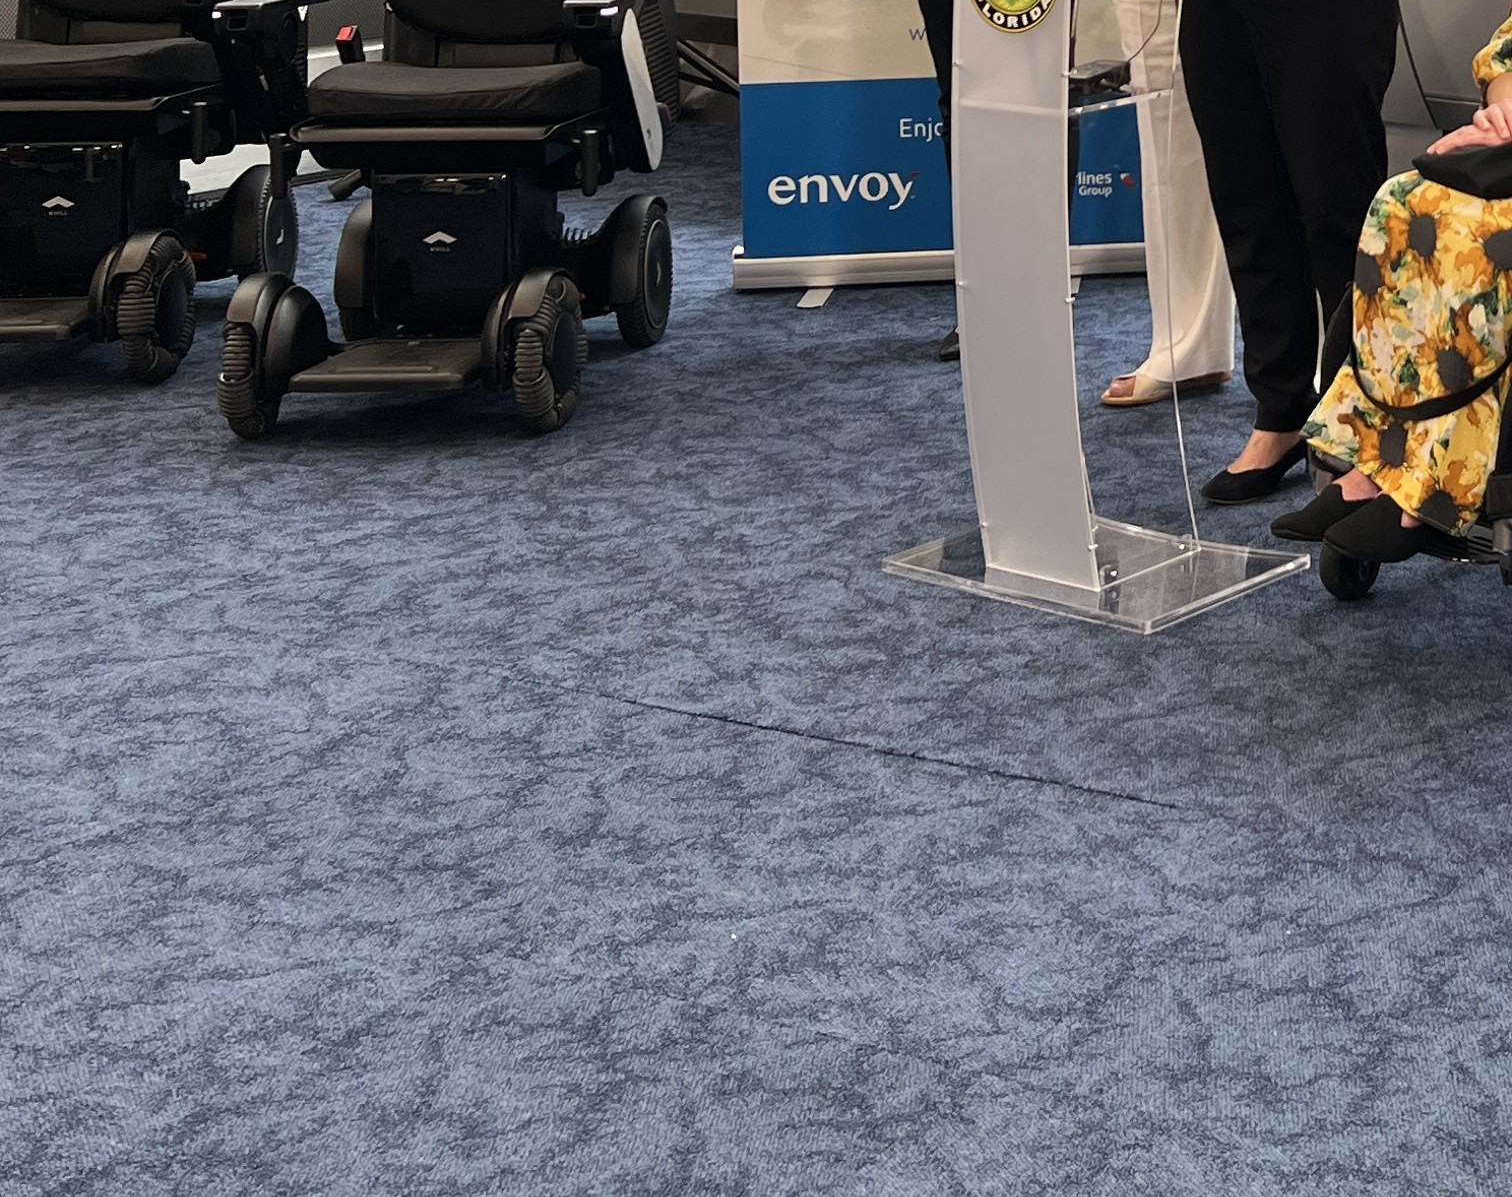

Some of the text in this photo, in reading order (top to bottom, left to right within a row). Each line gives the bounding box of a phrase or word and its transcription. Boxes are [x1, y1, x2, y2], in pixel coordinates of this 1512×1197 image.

[1076, 171, 1113, 185] lines
[767, 171, 914, 211] envoy
[1079, 185, 1113, 198] Group
